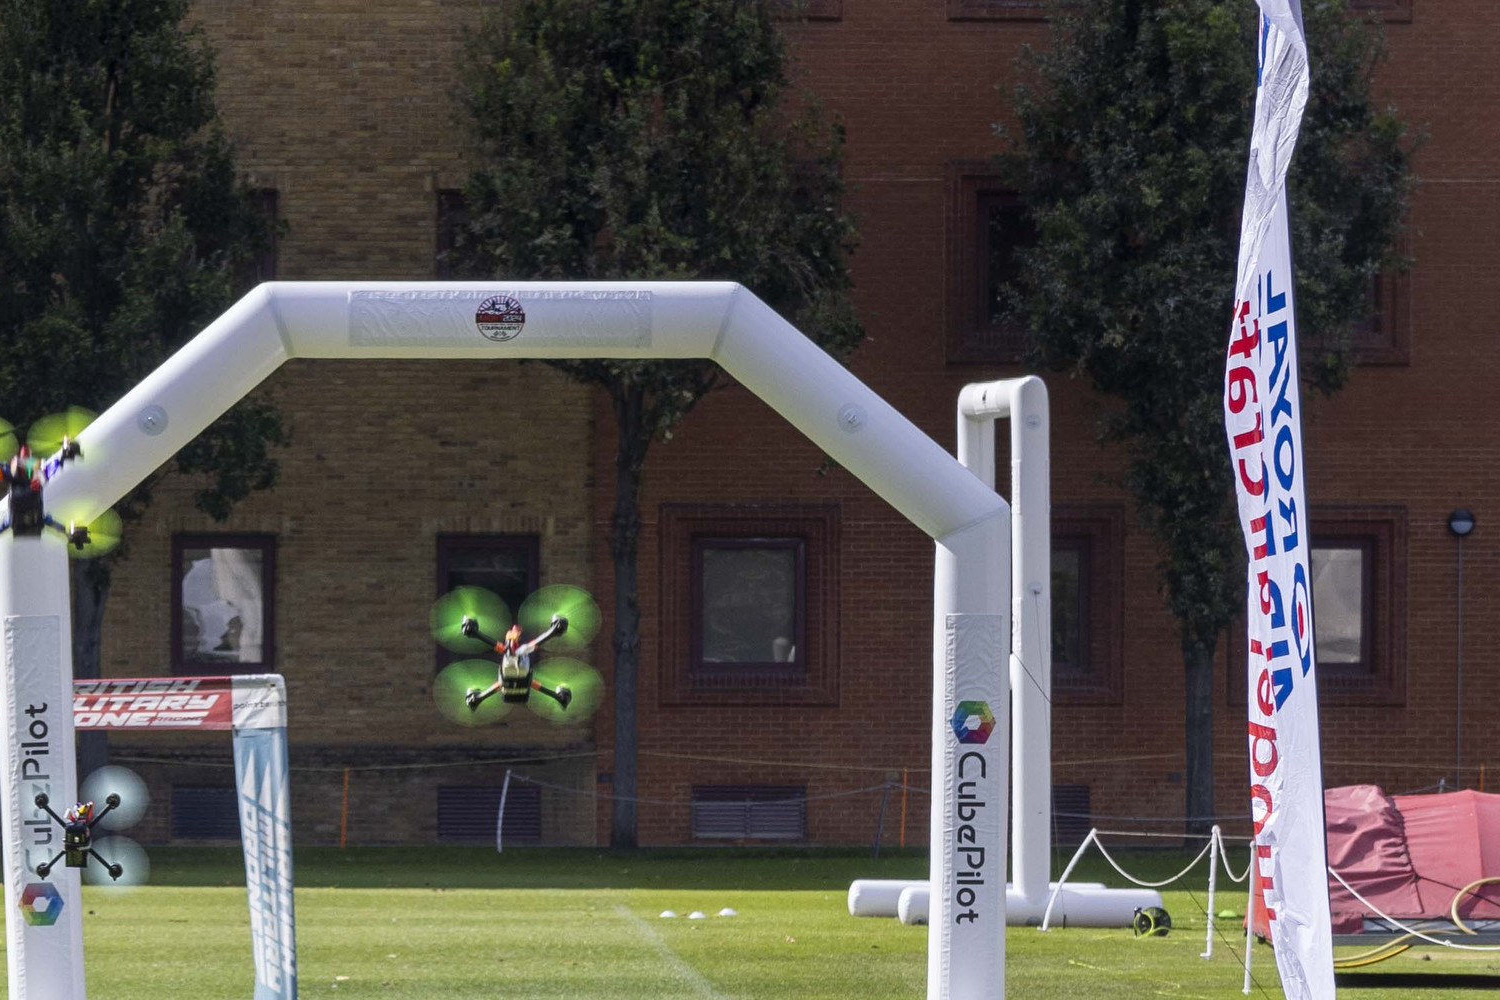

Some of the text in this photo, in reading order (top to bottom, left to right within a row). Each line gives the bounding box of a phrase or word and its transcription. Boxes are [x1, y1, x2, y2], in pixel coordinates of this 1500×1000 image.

[74, 680, 201, 695] RITISH
[74, 694, 220, 711] LITARY
[74, 712, 157, 727] ONE
[242, 798, 263, 937] DRONE
[956, 752, 987, 925] CubePilot
[259, 811, 281, 994] MILITARY
